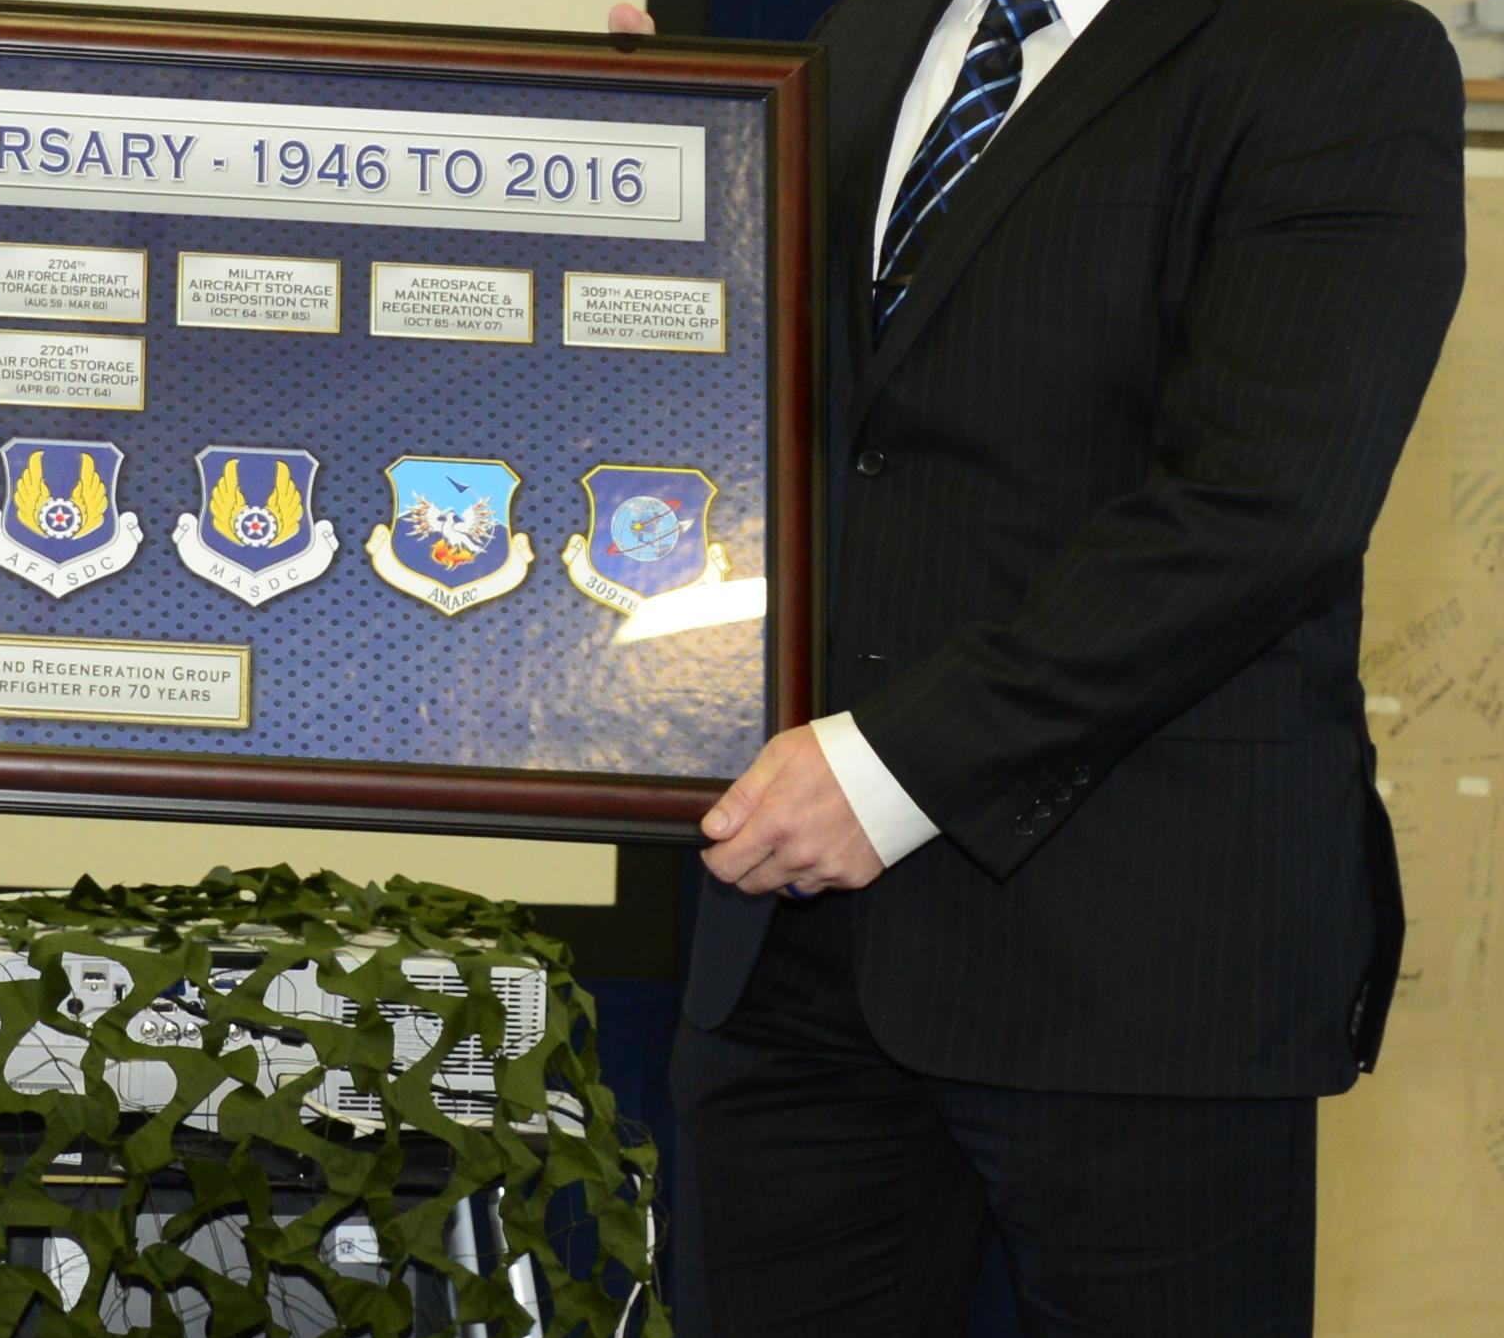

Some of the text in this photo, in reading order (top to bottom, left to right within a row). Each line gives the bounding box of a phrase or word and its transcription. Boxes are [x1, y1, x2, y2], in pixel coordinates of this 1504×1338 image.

[252, 138, 388, 193] 1946
[406, 146, 484, 198] TO
[504, 151, 643, 206] 2016
[3, 268, 129, 286] AIR FORCE AIRCRAFT
[227, 267, 294, 282] MILITARY
[49, 283, 59, 296] &
[59, 283, 89, 297] DISP
[88, 285, 141, 300] BRANCH
[187, 277, 334, 297] AIRCRAFT STORAGE
[409, 276, 497, 293] AEROSPACE
[23, 296, 109, 311] (AUG 59 MAR 60)
[190, 290, 330, 310] & DISPOSITION CTR
[393, 288, 513, 306] MAINTENANCE &
[622, 287, 711, 304] AEROSPACE
[209, 305, 311, 322] (OCT 64 SEP 85)
[381, 300, 525, 319] REGENERATION CTR
[585, 298, 706, 316] MAINTENANCE &
[402, 315, 503, 331] (OCT 85 MAY 07)
[571, 309, 720, 329] REGENERATION GRP
[586, 325, 705, 341] (MAY 07 CURRENT)
[19, 355, 68, 370] FORCE
[68, 357, 135, 374] STORAGE
[0, 367, 88, 384] DISPOSITION
[89, 371, 140, 387] GROUP
[14, 382, 112, 398] (APR 60 OCT 64)
[427, 587, 478, 612] AMARC
[31, 658, 166, 681] REGENERATION
[170, 664, 232, 684] GROUP
[87, 683, 122, 698] FOR
[127, 682, 151, 700] 70
[156, 686, 212, 703] YEARS
